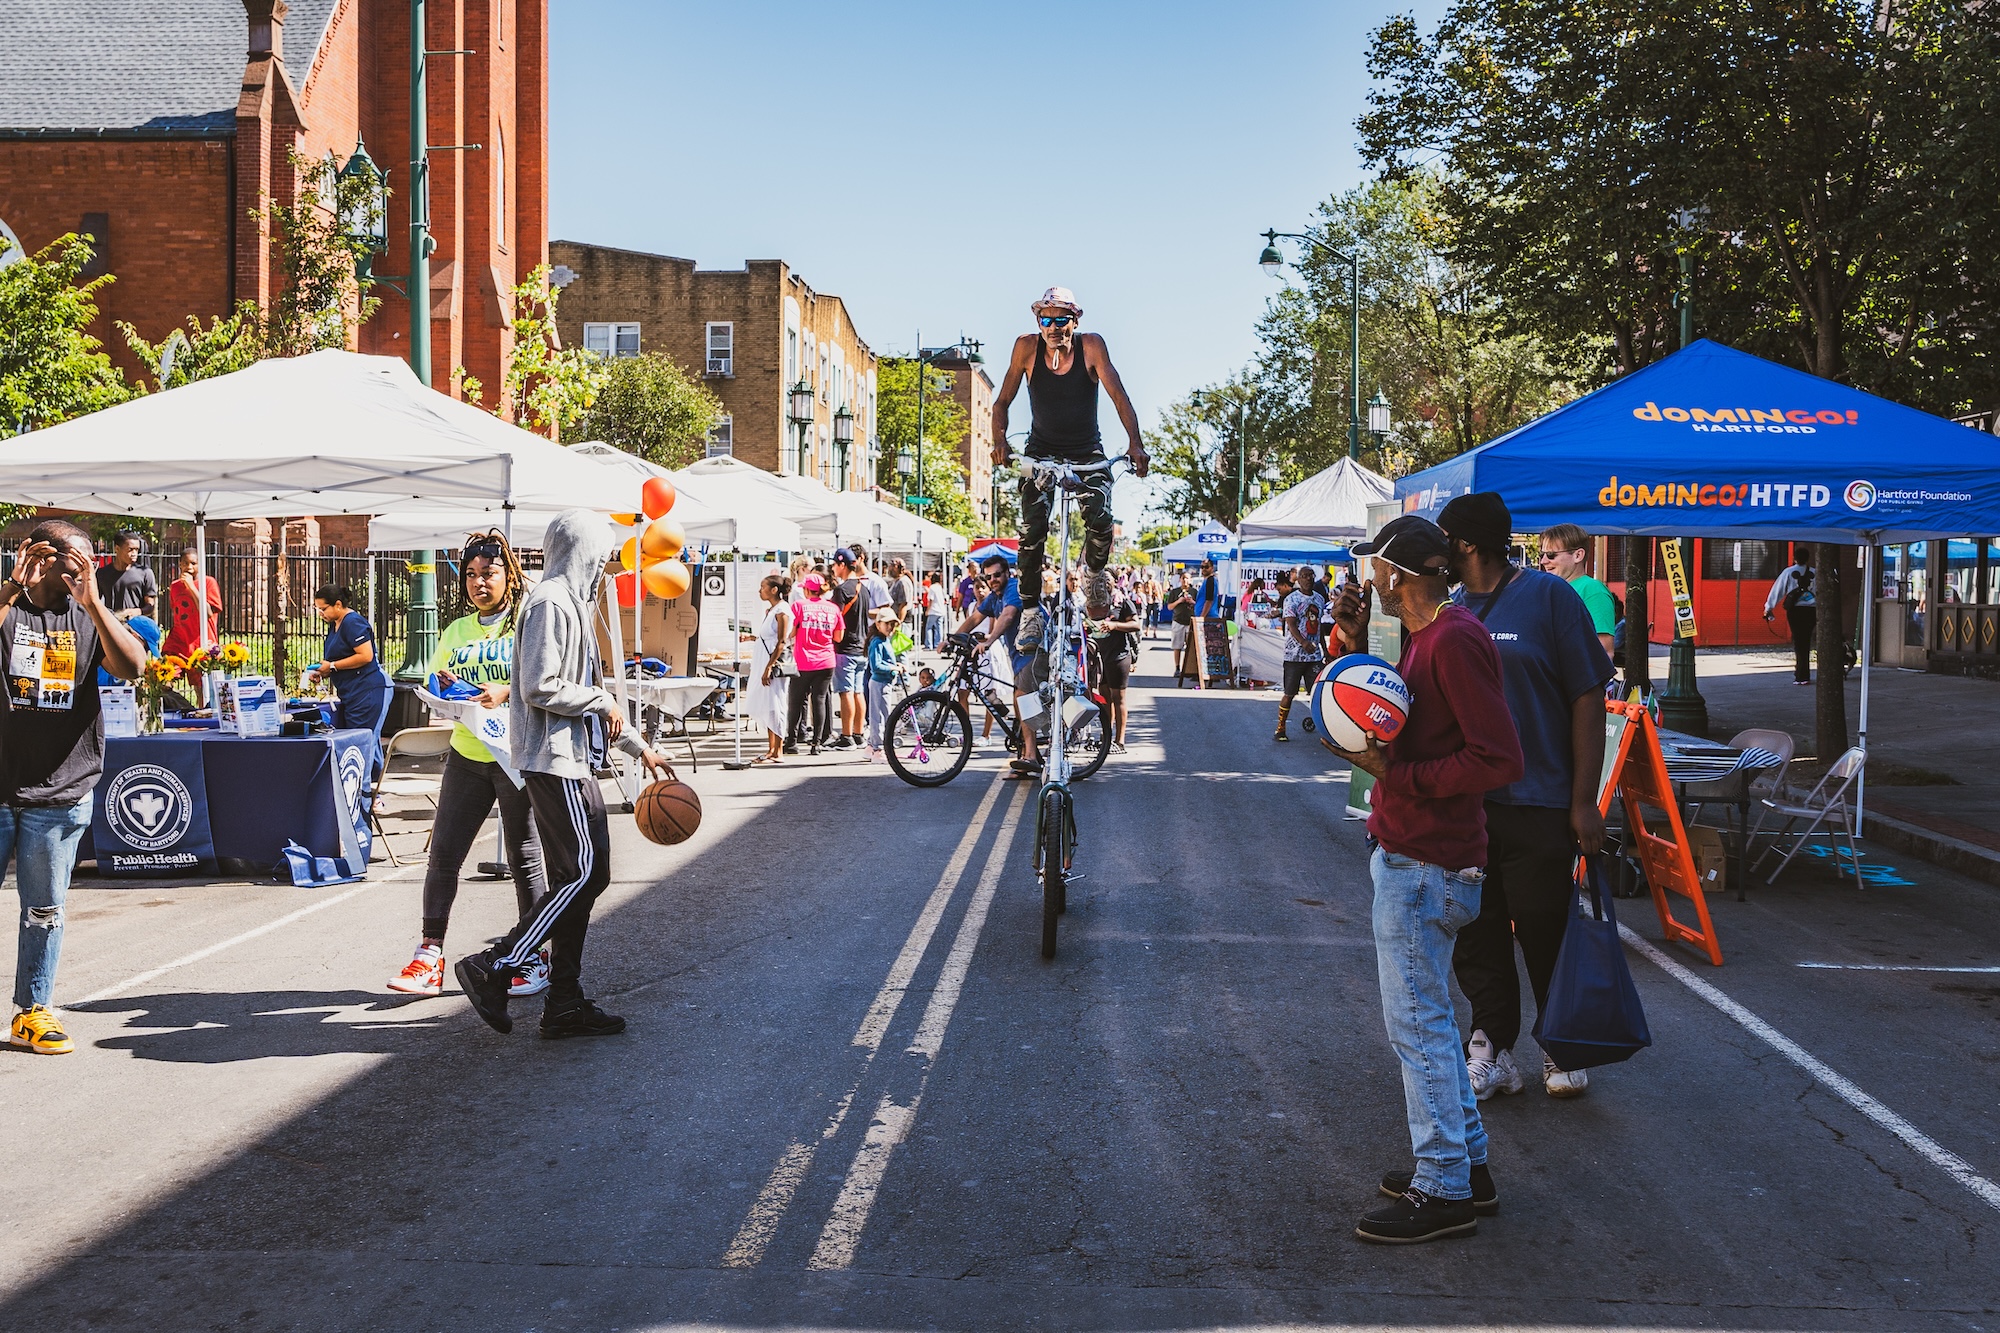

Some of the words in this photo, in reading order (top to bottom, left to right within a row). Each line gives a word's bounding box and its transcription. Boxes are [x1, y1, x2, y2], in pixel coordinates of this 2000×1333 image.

[1692, 423, 1817, 434] HARTFORD
[1750, 483, 1831, 508] HTFD
[1877, 490, 1918, 499] Hartford
[1920, 490, 1972, 501] Foundation
[1203, 534, 1225, 542] 311
[1665, 543, 1677, 559] NO
[1670, 563, 1685, 596] PARK
[57, 630, 76, 638] SAT
[57, 637, 76, 645] OCT
[1496, 633, 1519, 641] CORPS
[478, 637, 513, 664] YOU
[449, 665, 480, 682] NOW
[109, 785, 121, 826] DEPARTMENT
[117, 776, 124, 785] OF
[124, 768, 148, 780] HEALTH
[147, 768, 163, 776] AND
[162, 772, 182, 793] HUMAN
[179, 791, 189, 822] SERVICES
[125, 833, 139, 844] CITY
[149, 830, 180, 847] HARTFORD
